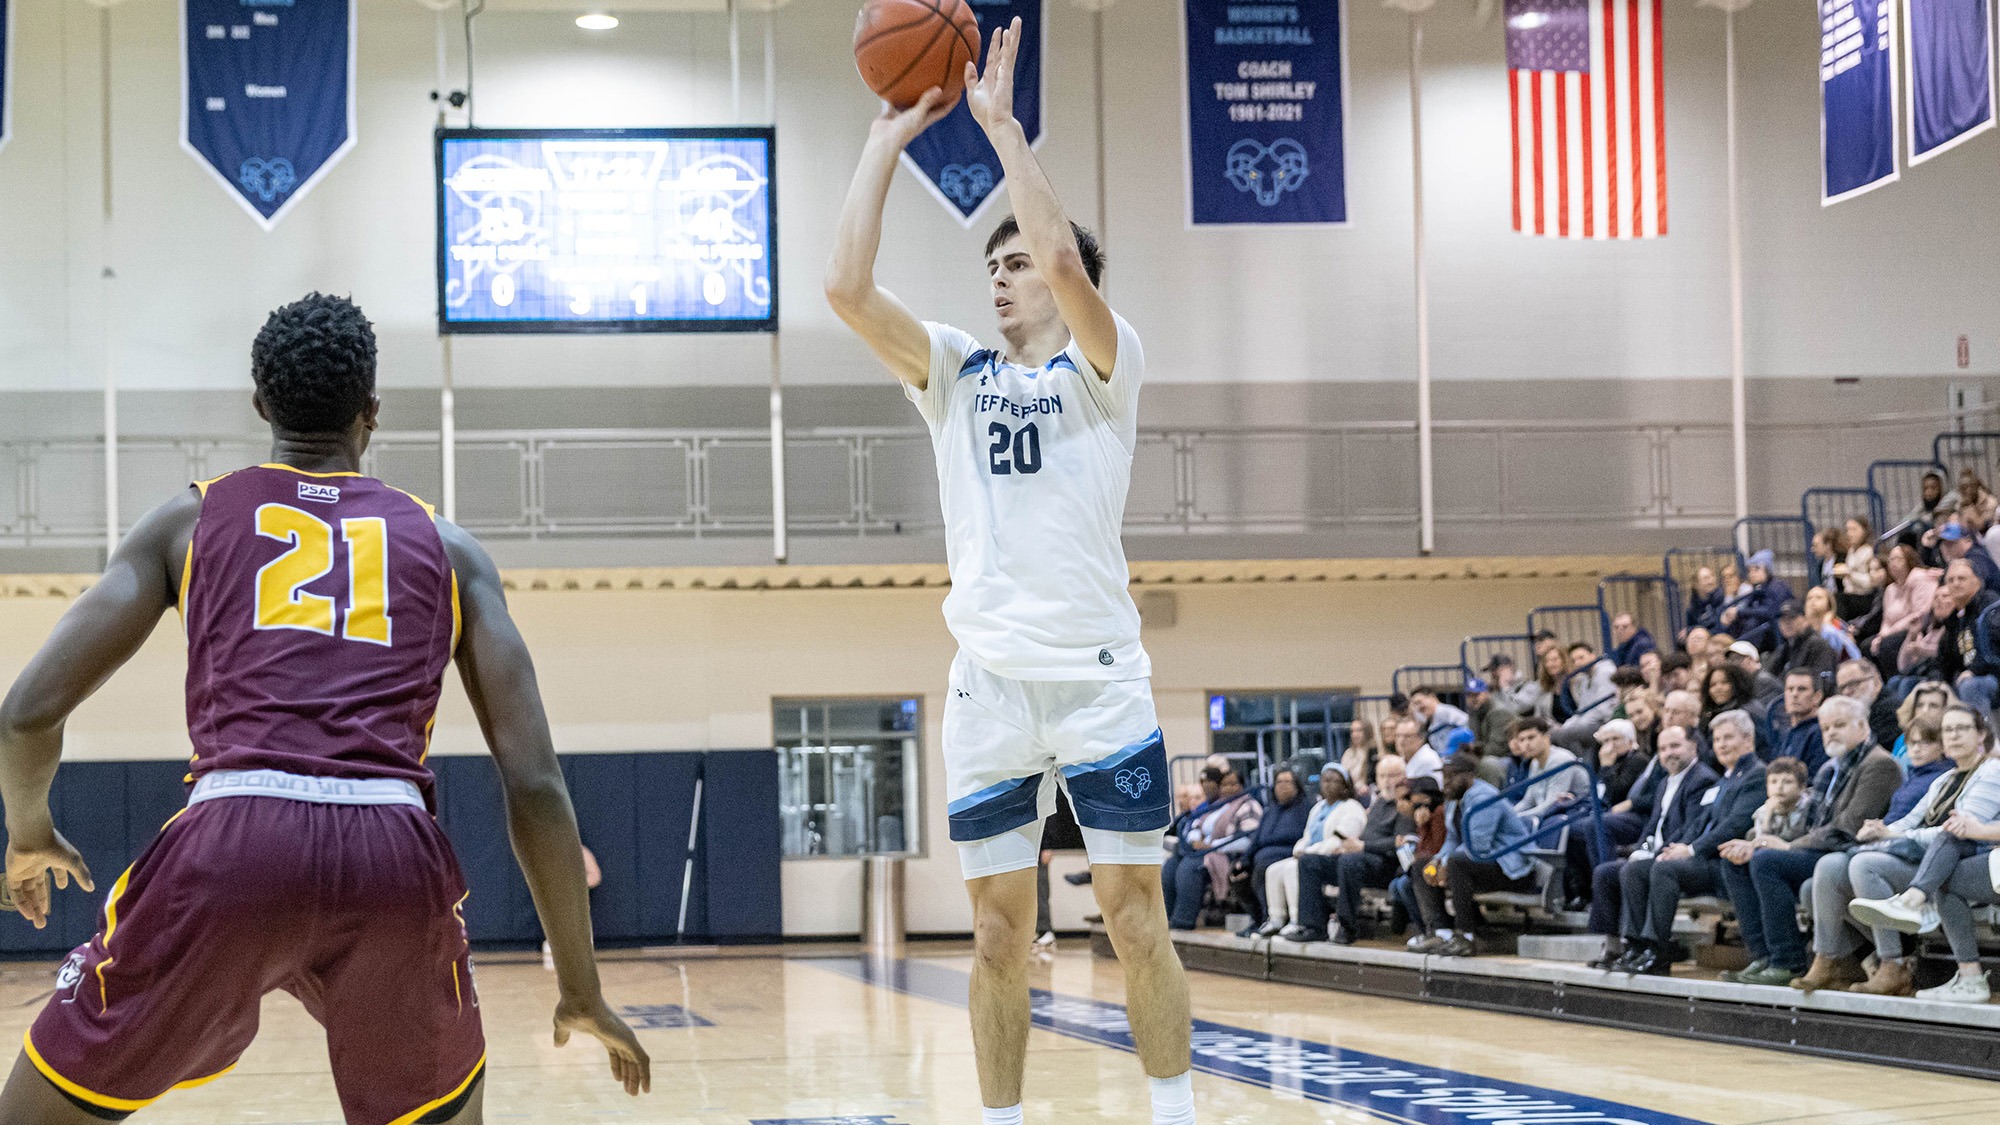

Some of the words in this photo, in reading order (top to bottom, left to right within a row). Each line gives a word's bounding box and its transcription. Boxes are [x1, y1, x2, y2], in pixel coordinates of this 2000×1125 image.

[1214, 27, 1313, 44] BASKETBALL
[1237, 61, 1292, 79] COACH
[1213, 82, 1249, 100] TOM
[1251, 81, 1316, 100] SHIRLEY
[492, 273, 516, 306] 0
[629, 284, 646, 315] 1
[703, 272, 726, 305] 0
[988, 421, 1042, 475] 20
[300, 484, 338, 497] PSAC
[253, 502, 392, 648] 21
